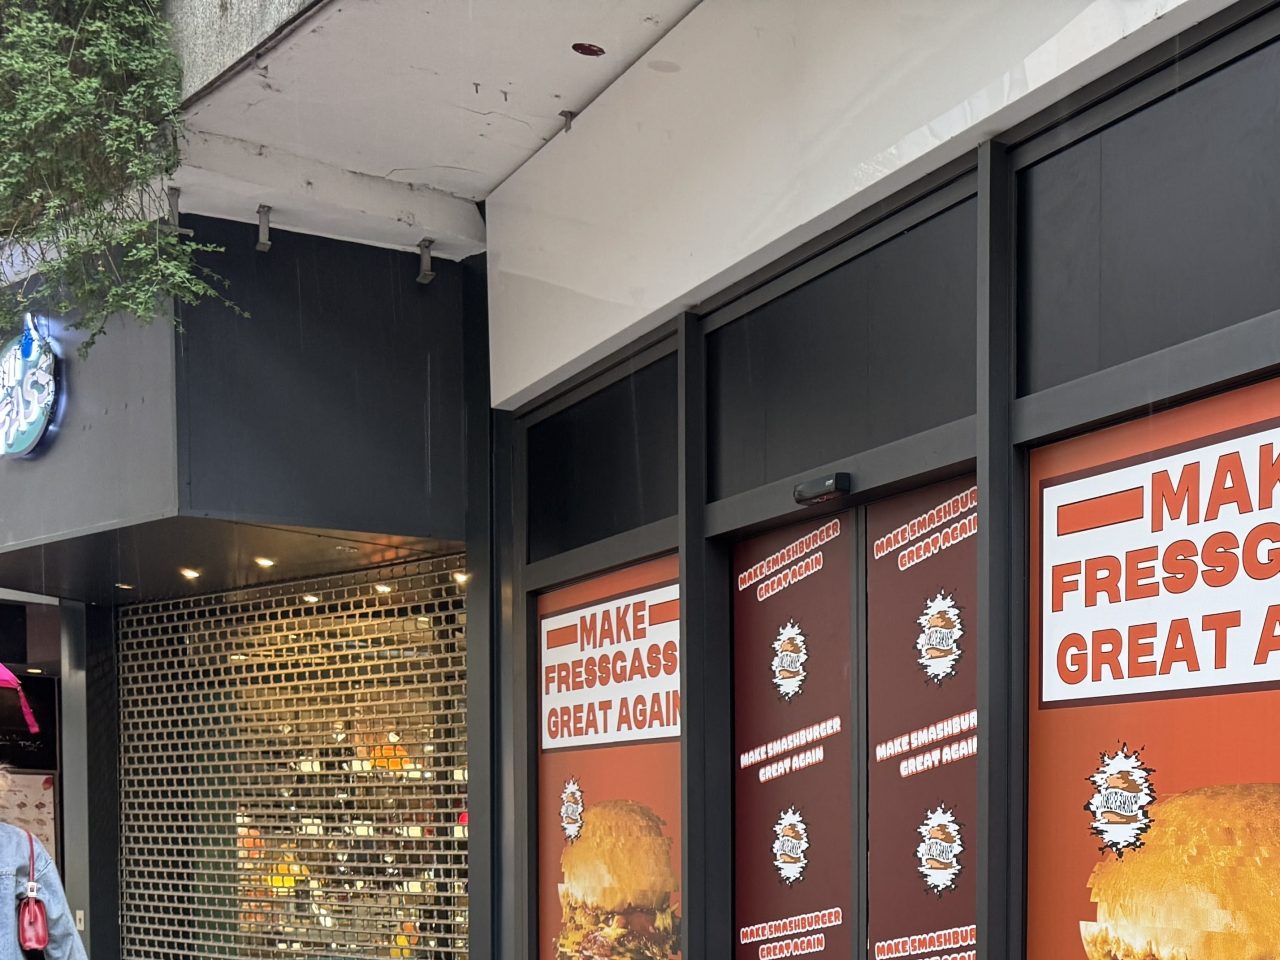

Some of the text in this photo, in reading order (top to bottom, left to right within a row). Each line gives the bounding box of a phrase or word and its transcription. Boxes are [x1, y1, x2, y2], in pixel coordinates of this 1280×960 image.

[874, 485, 977, 560] MAKE SMASHBUR
[898, 513, 977, 571] GREAT AGAI
[738, 518, 841, 591] MAKE SMASHBURGER
[756, 551, 824, 602] GREAT AGAIN
[579, 600, 647, 652] MAKE
[1056, 610, 1242, 686] GREAT
[544, 640, 678, 696] FRESSGASS
[547, 700, 613, 740] GREAT
[740, 715, 842, 769] MAKE SMASHBURGER
[876, 709, 977, 763] MAKE SMASHBUR
[759, 745, 824, 783] GREAT AGAIN
[899, 735, 977, 778] GREAT AGAI
[739, 907, 843, 945] MAKE SMASHBURGER
[791, 933, 825, 956] AGAIN
[875, 925, 977, 960] MAKE SMASHBUR
